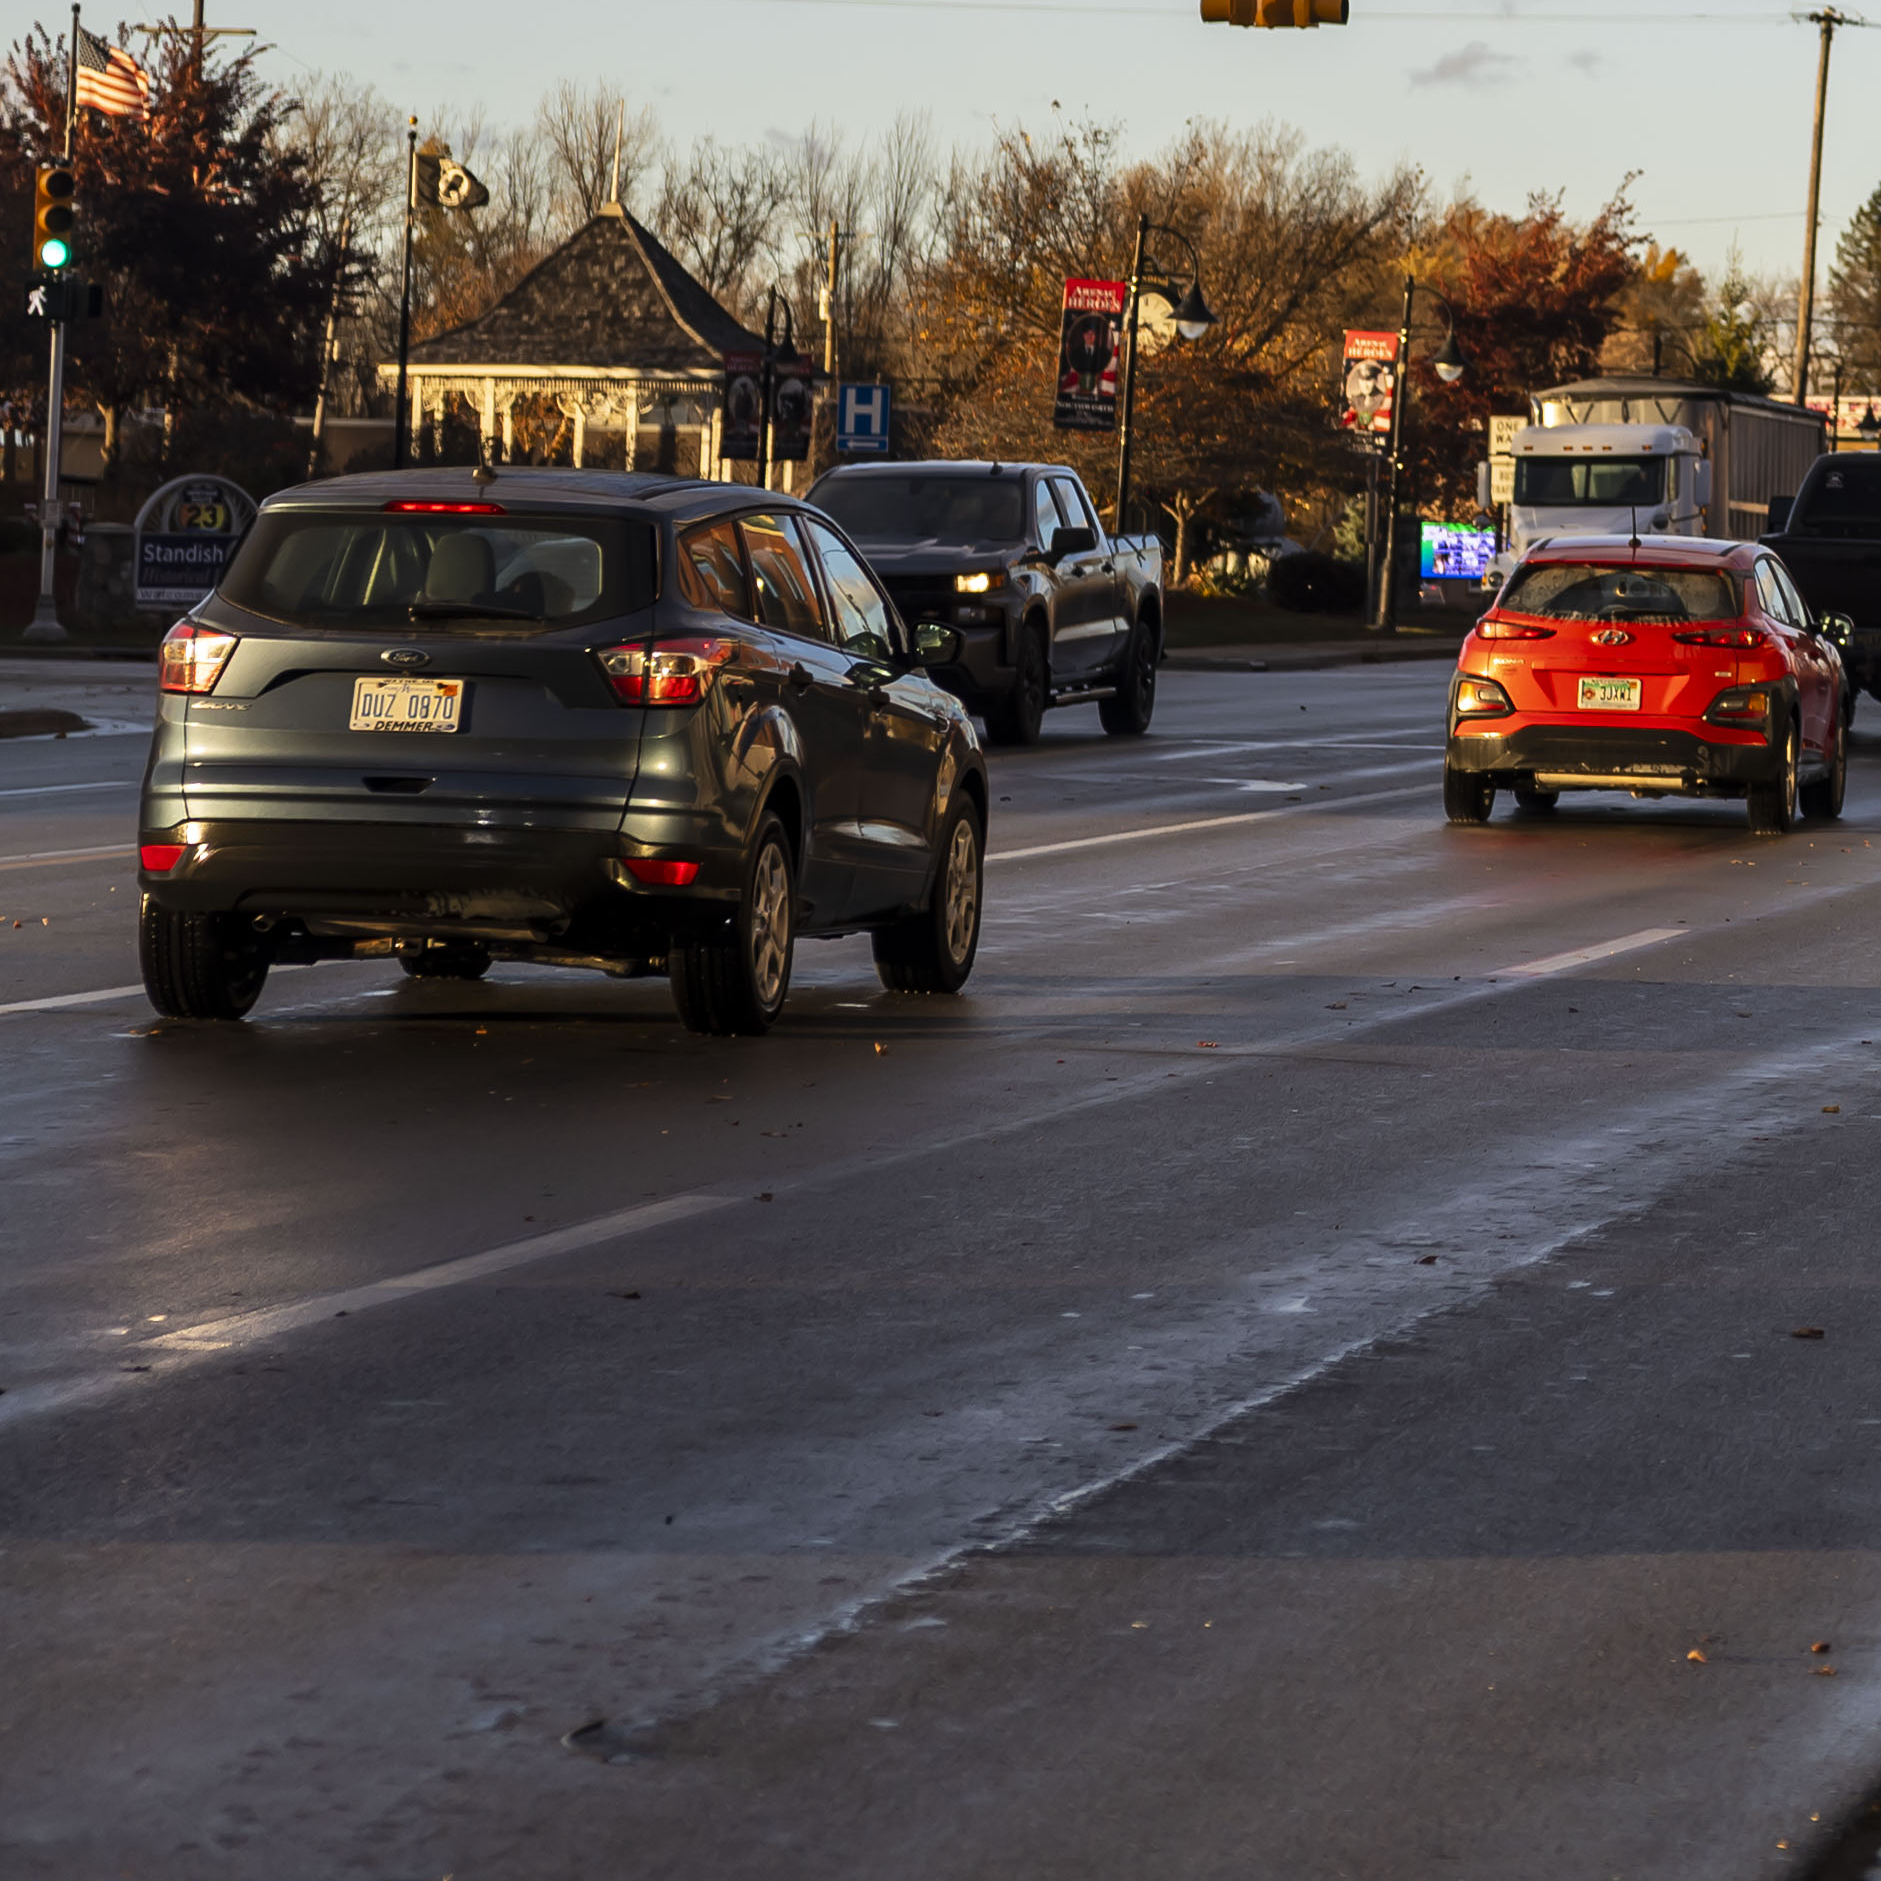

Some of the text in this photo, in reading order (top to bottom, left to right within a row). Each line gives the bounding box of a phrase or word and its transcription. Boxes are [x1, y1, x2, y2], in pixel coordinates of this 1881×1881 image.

[844, 388, 882, 434] H
[1496, 421, 1519, 432] ONE
[187, 504, 217, 528] 23
[143, 543, 224, 563] Standish
[361, 694, 454, 719] DUZ 0870
[374, 721, 434, 731] DEMMER
